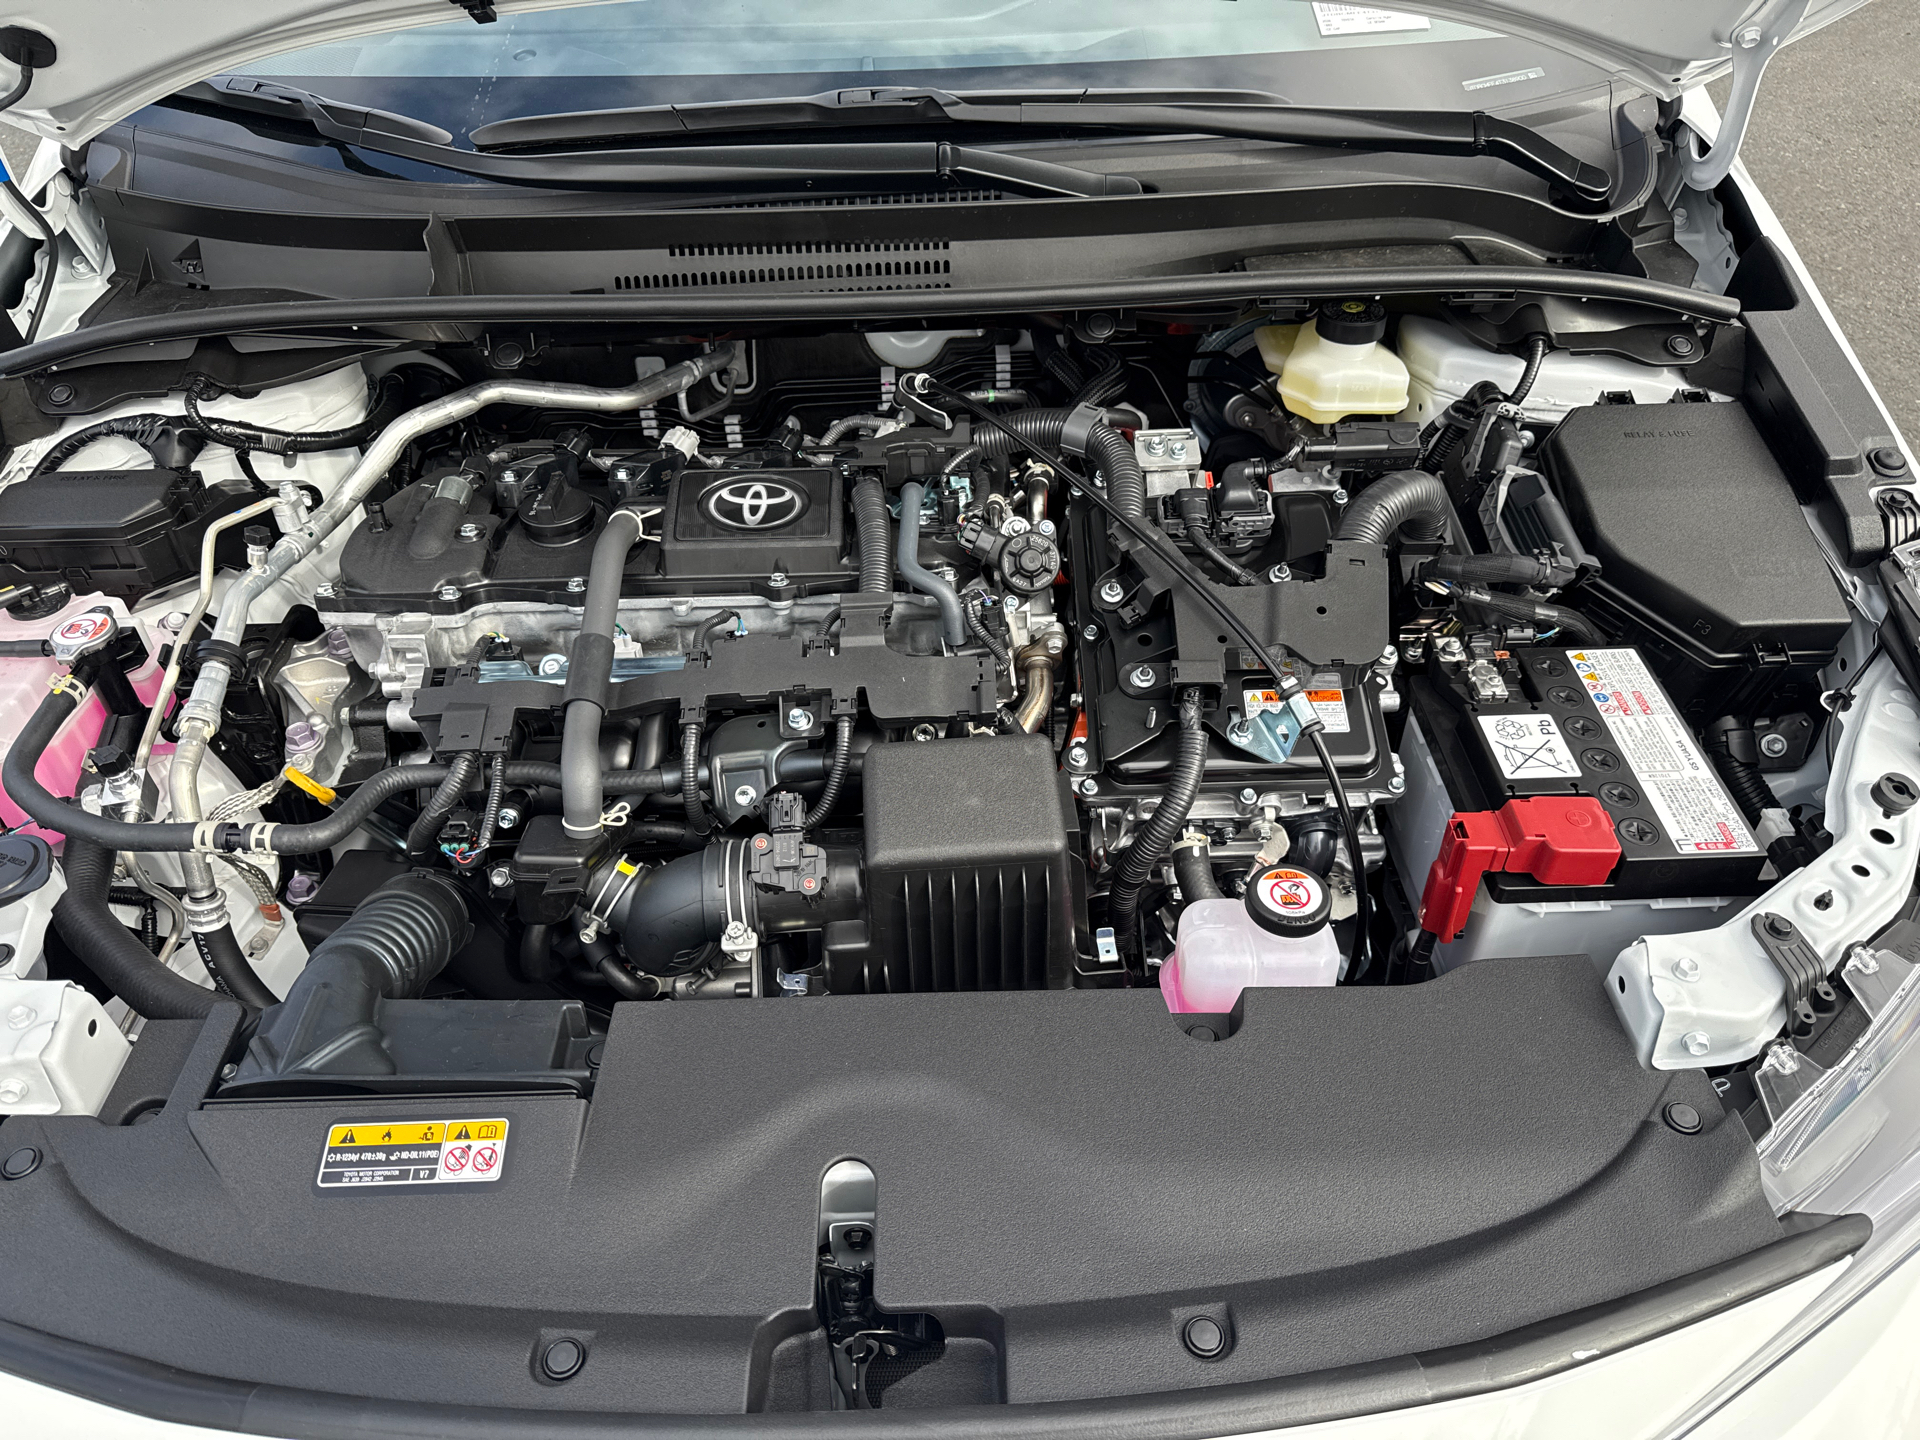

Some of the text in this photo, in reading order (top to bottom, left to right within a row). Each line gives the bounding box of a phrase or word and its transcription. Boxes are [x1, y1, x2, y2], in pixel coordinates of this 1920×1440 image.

[1035, 575, 1051, 587] TOYOTA
[1693, 618, 1712, 635] F3
[1538, 720, 1556, 735] Pb
[1674, 739, 1700, 770] GS YUASA
[1717, 822, 1735, 842] DANGER
[1277, 914, 1316, 924] DENSO
[197, 933, 216, 969] ACV17
